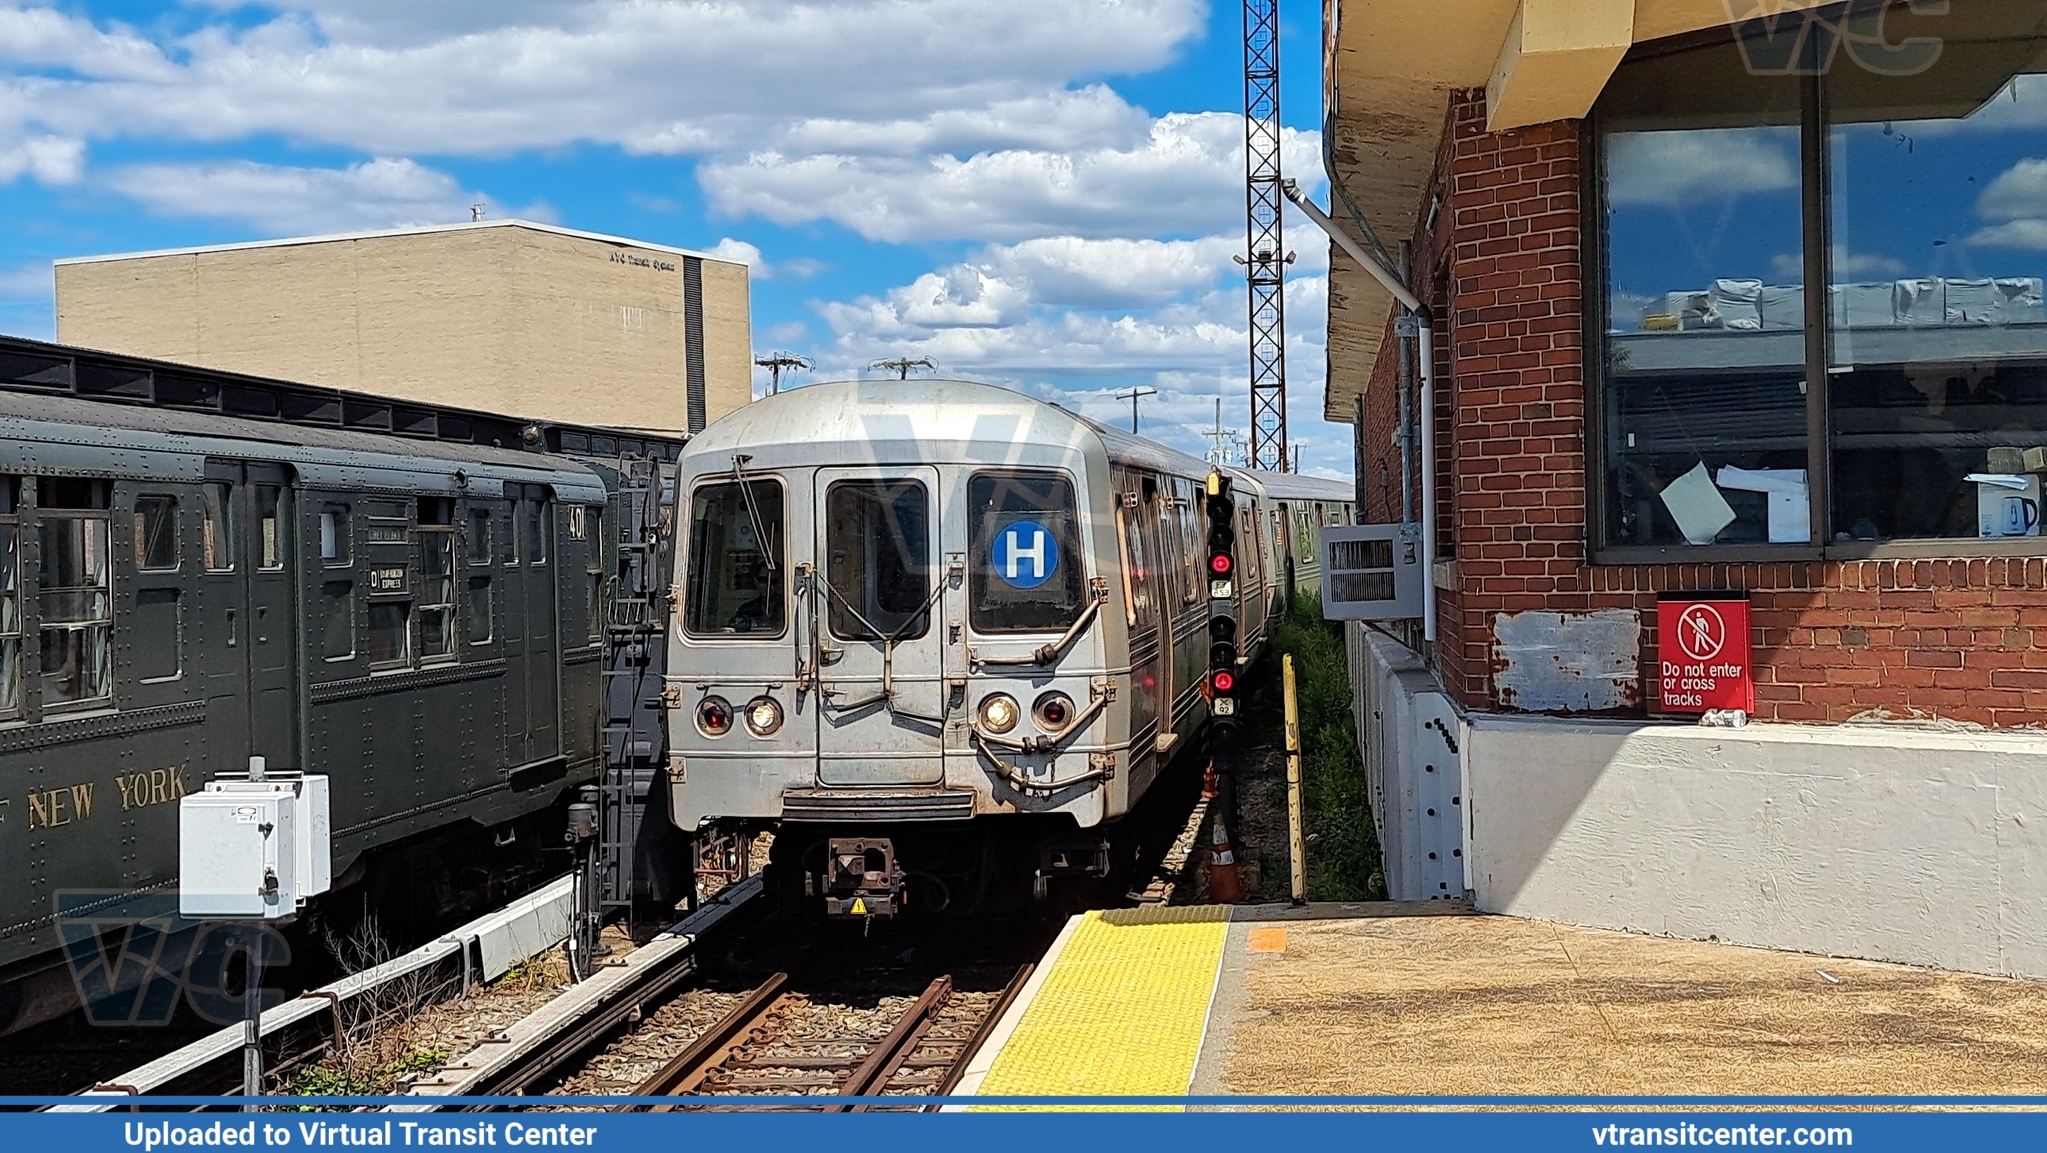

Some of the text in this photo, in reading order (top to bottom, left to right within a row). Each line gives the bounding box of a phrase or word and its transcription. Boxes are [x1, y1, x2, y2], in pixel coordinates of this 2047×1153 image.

[569, 507, 586, 538] 401
[1006, 531, 1045, 578] H
[1662, 660, 1742, 678] Do not enter
[1663, 678, 1716, 691] or cross
[1664, 691, 1703, 706] tracks
[27, 782, 94, 832] NEW
[115, 764, 189, 812] YORK
